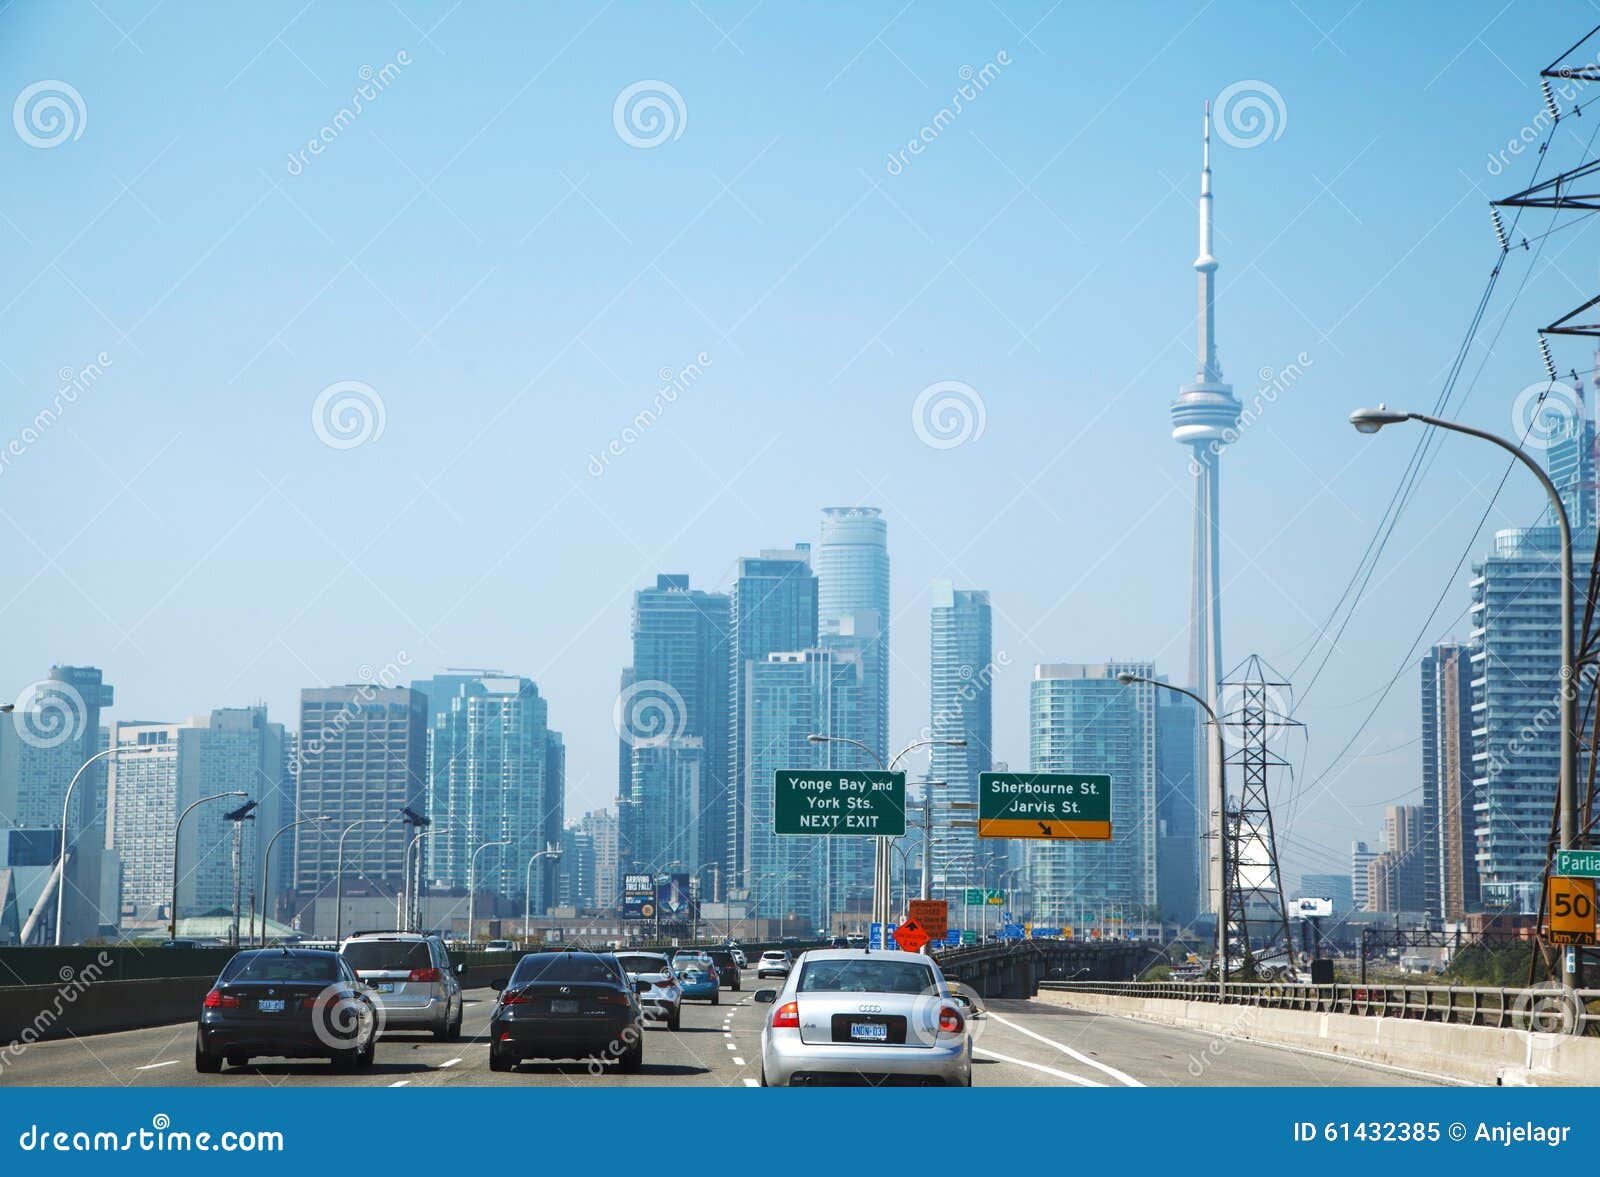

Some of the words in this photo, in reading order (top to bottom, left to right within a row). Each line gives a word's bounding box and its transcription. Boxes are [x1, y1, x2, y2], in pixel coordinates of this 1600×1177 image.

[789, 777, 833, 793] Yonge
[839, 778, 866, 793] Bay
[871, 781, 893, 791] and
[991, 780, 1074, 794] Sherbourne
[1080, 782, 1100, 795] St.
[807, 796, 840, 809] York
[847, 797, 874, 809] Sts.
[1009, 800, 1056, 813] Jarvis
[1062, 801, 1081, 814] St.
[800, 815, 840, 827] NEXT
[846, 815, 880, 828] EXIT
[1555, 893, 1591, 918] 50
